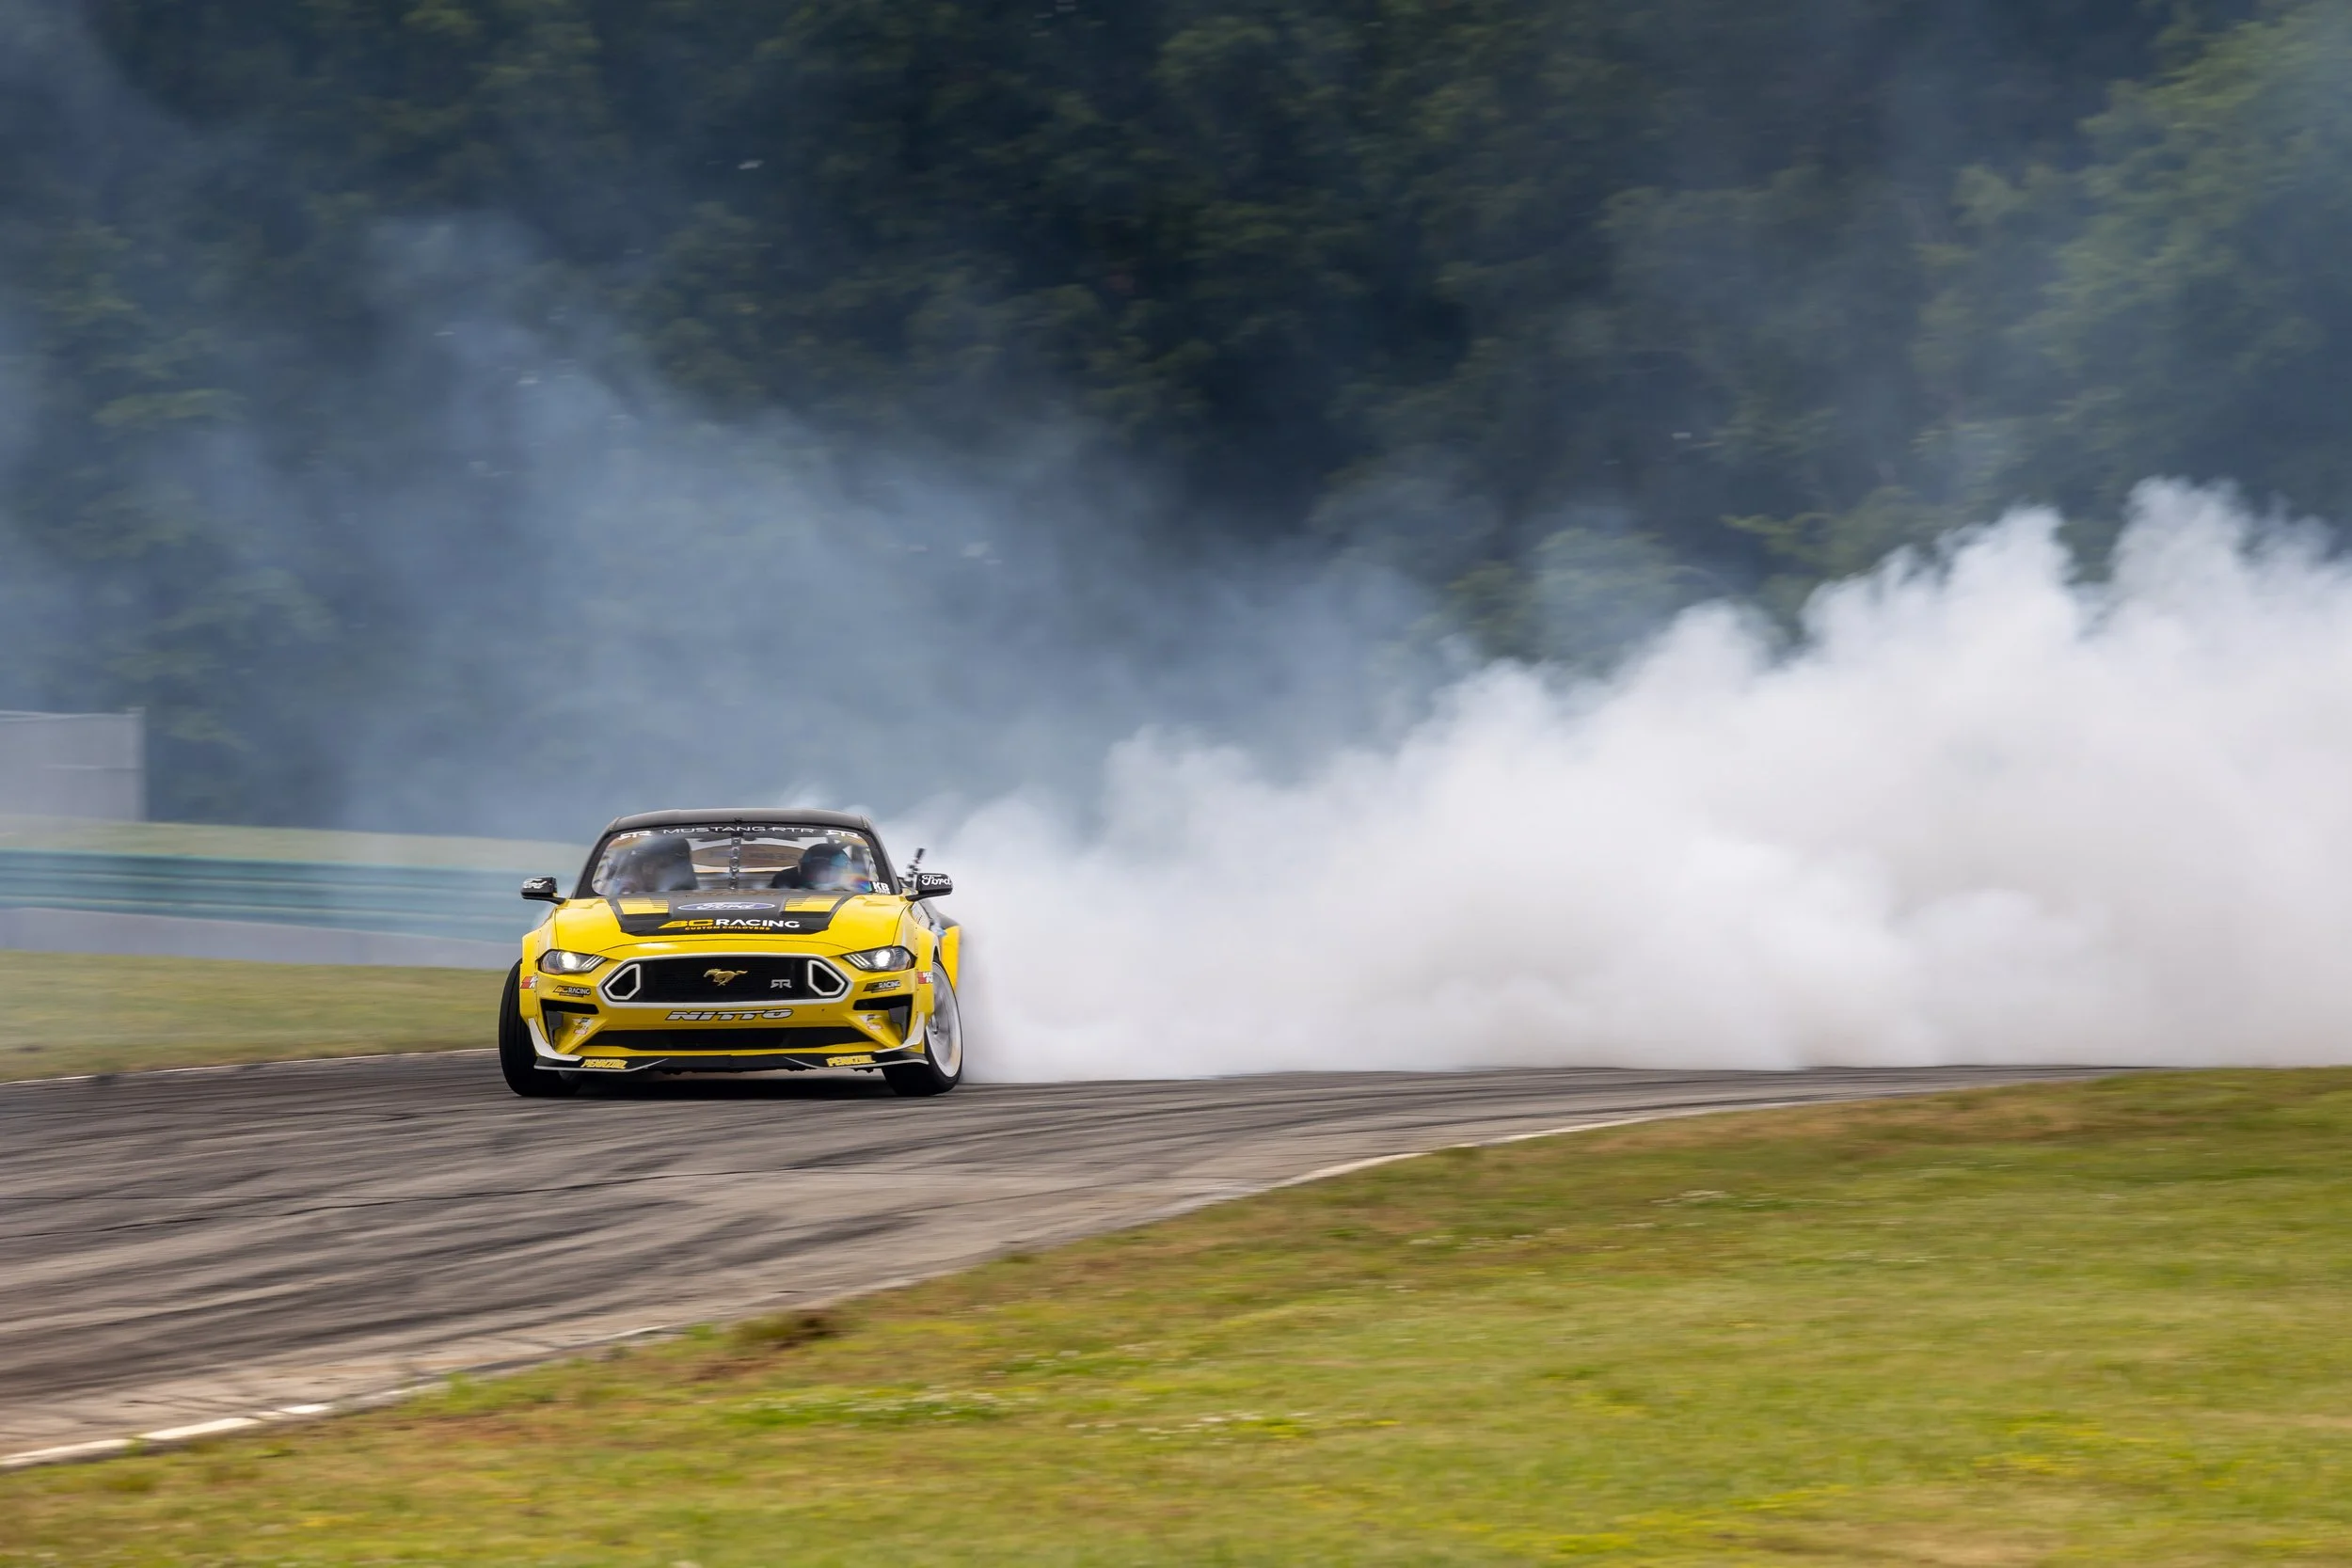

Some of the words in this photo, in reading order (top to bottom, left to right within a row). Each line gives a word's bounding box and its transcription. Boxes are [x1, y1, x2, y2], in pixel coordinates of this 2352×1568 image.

[662, 826, 766, 834] MUSTANG
[921, 874, 952, 886] Ford
[715, 918, 801, 929] RACING
[568, 987, 591, 995] RACING
[665, 1008, 794, 1022] NITTO
